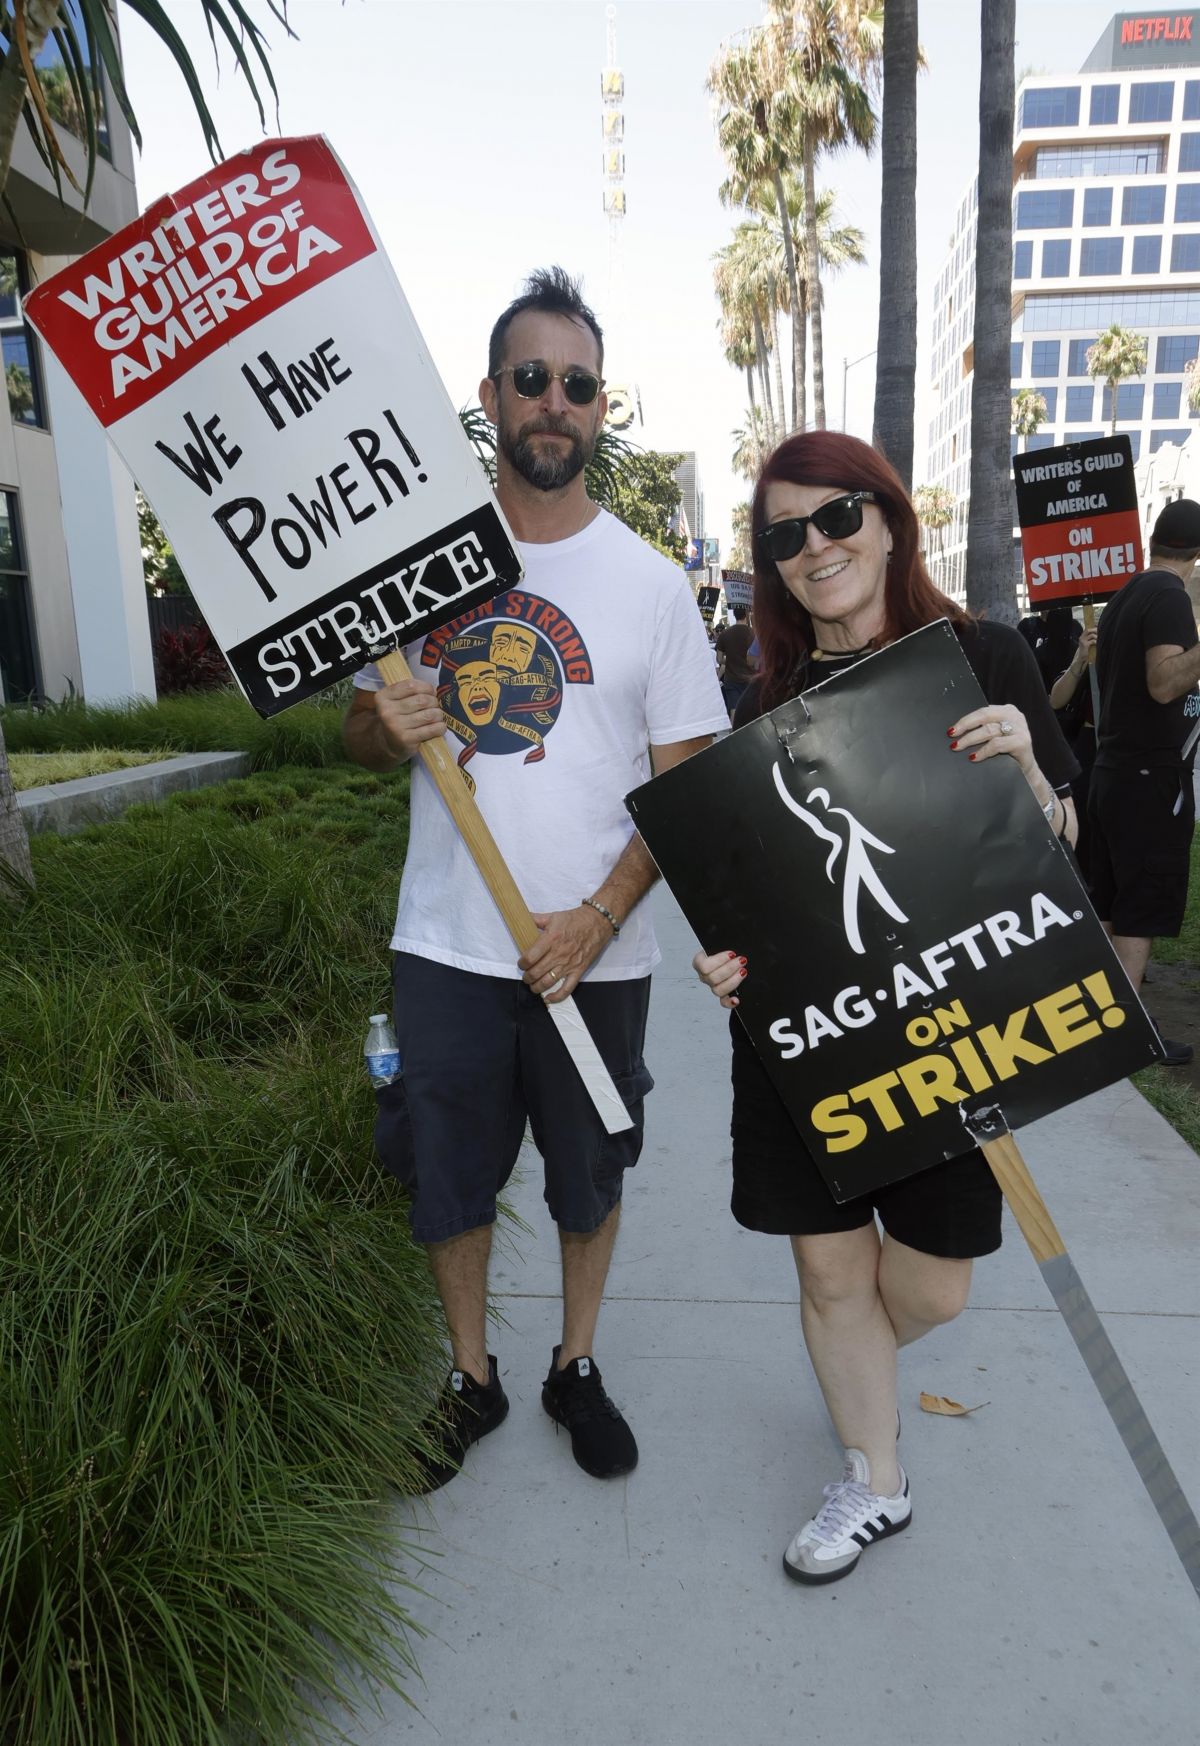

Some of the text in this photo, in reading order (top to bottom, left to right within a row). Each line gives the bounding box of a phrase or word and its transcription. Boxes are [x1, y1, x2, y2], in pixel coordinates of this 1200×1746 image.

[1121, 16, 1193, 44] NETFLIX
[59, 149, 301, 320] WRITERS
[94, 200, 305, 351] GUILD OF
[111, 225, 343, 398] AMERICA
[155, 338, 352, 496] WE HAVE
[1020, 452, 1124, 484] WRITERS GUILD
[1067, 480, 1082, 493] OF
[1046, 493, 1108, 517] AMERICA
[1068, 527, 1093, 547] ON
[1030, 543, 1136, 586] STRIKE!
[257, 531, 496, 697] STRIKE
[422, 592, 591, 682] UNION STRONG
[905, 1000, 972, 1047] ON
[810, 969, 1127, 1153] STRIKE!
